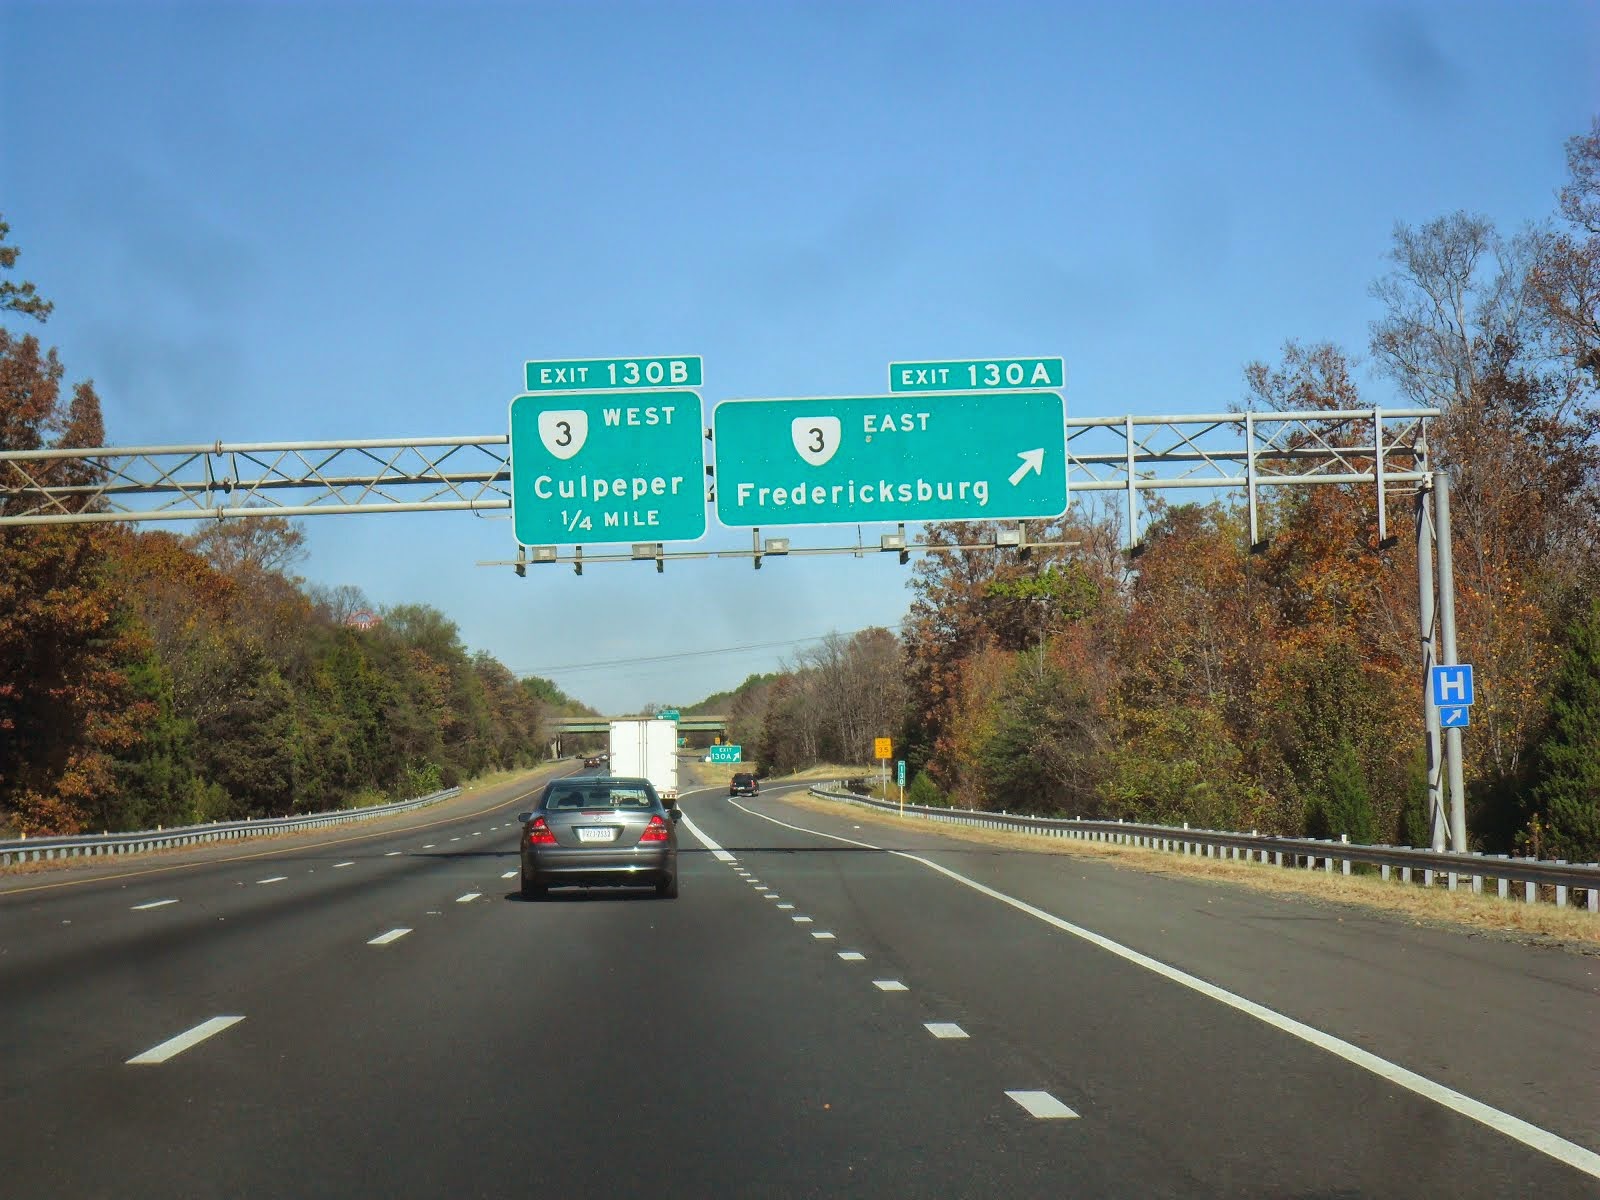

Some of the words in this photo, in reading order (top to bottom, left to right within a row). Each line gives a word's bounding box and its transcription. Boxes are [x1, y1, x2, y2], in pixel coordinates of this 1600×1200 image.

[540, 368, 589, 384] EXIT
[607, 361, 688, 385] 130B
[902, 368, 951, 385] EXIT
[968, 362, 1051, 386] 130A
[603, 407, 674, 427] WEST
[864, 413, 930, 433] EAST
[555, 421, 572, 447] 3
[808, 427, 824, 453] 3
[534, 475, 683, 502] Culpeper
[736, 479, 989, 507] Fredericksburg
[561, 509, 592, 532] 1/4
[604, 510, 659, 527] MILE
[1440, 672, 1464, 700] H
